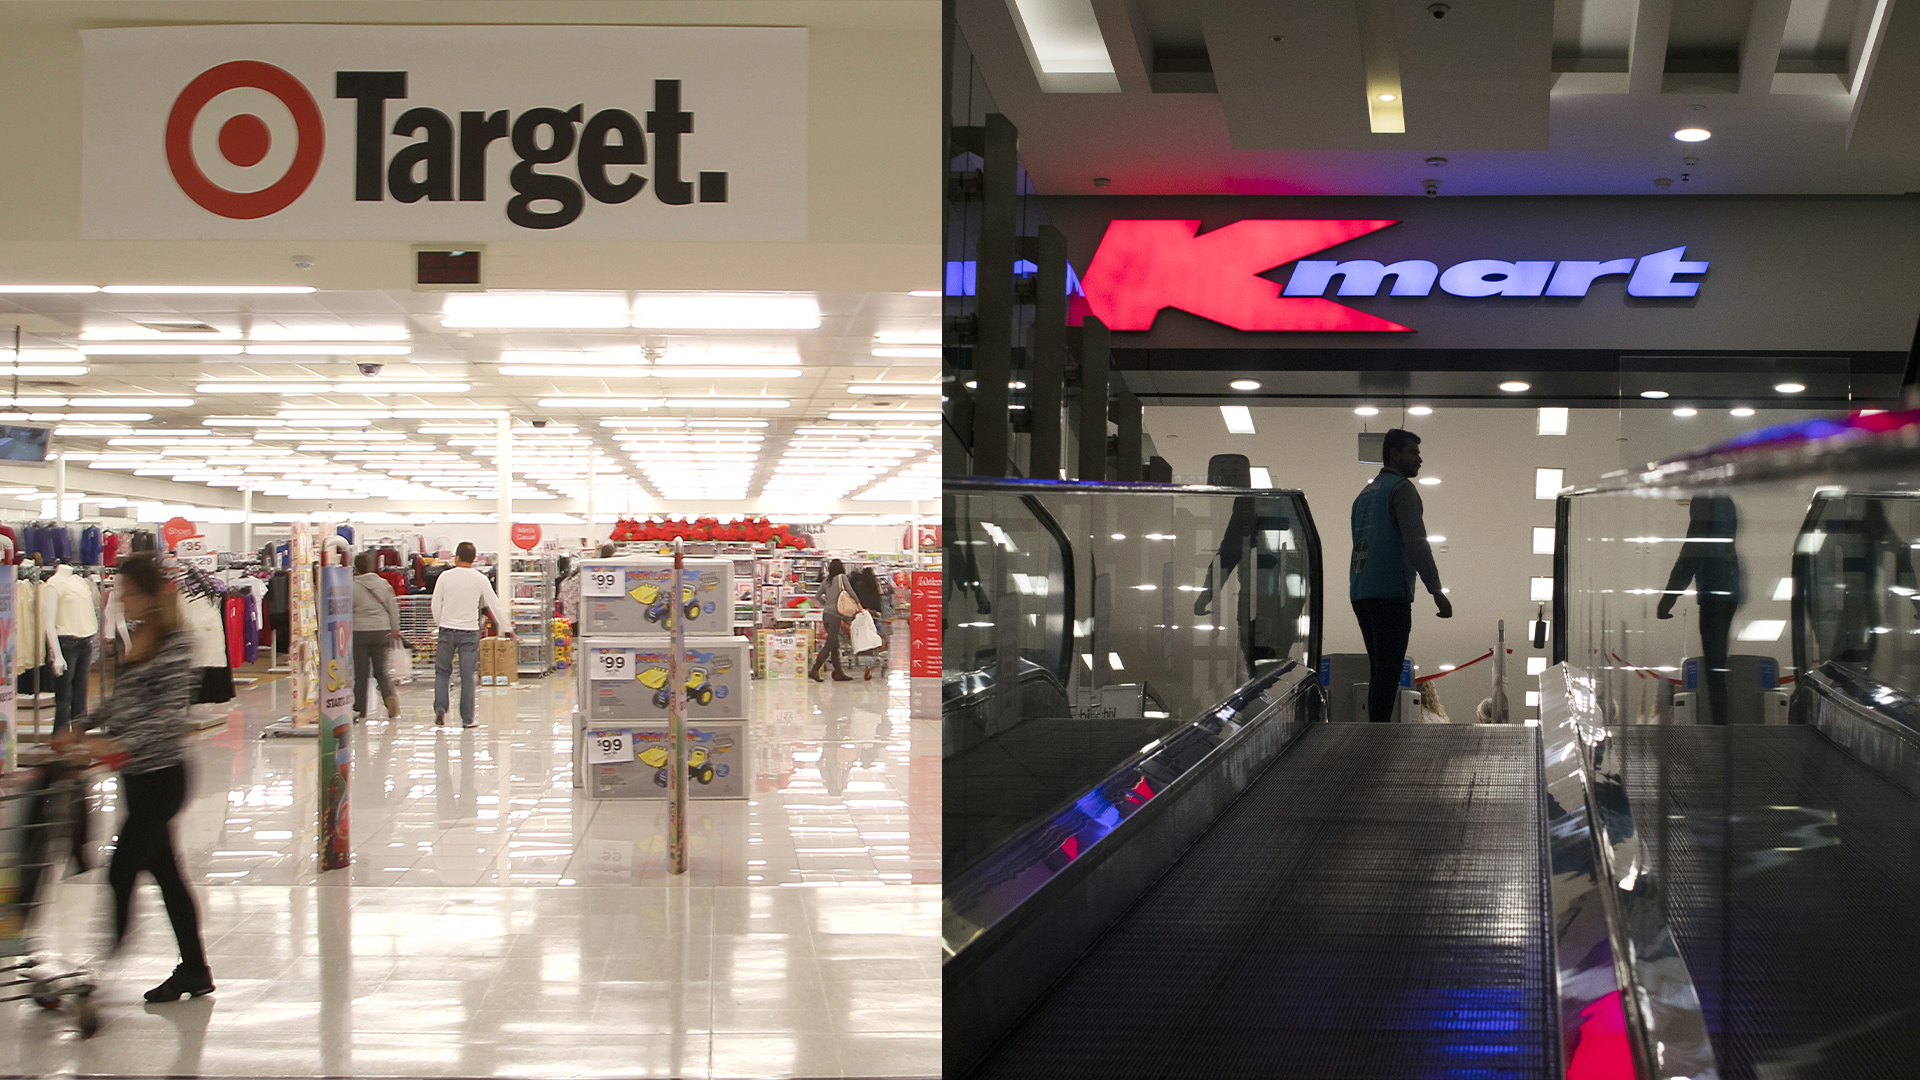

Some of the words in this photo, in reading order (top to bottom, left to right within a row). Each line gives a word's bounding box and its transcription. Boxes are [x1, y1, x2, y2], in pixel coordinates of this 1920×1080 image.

[1080, 219, 1711, 332] Kmart
[168, 526, 193, 536] Shoes
[181, 541, 202, 551] $35
[591, 574, 616, 586] $99
[600, 656, 625, 669] $99
[597, 738, 623, 752] $99
